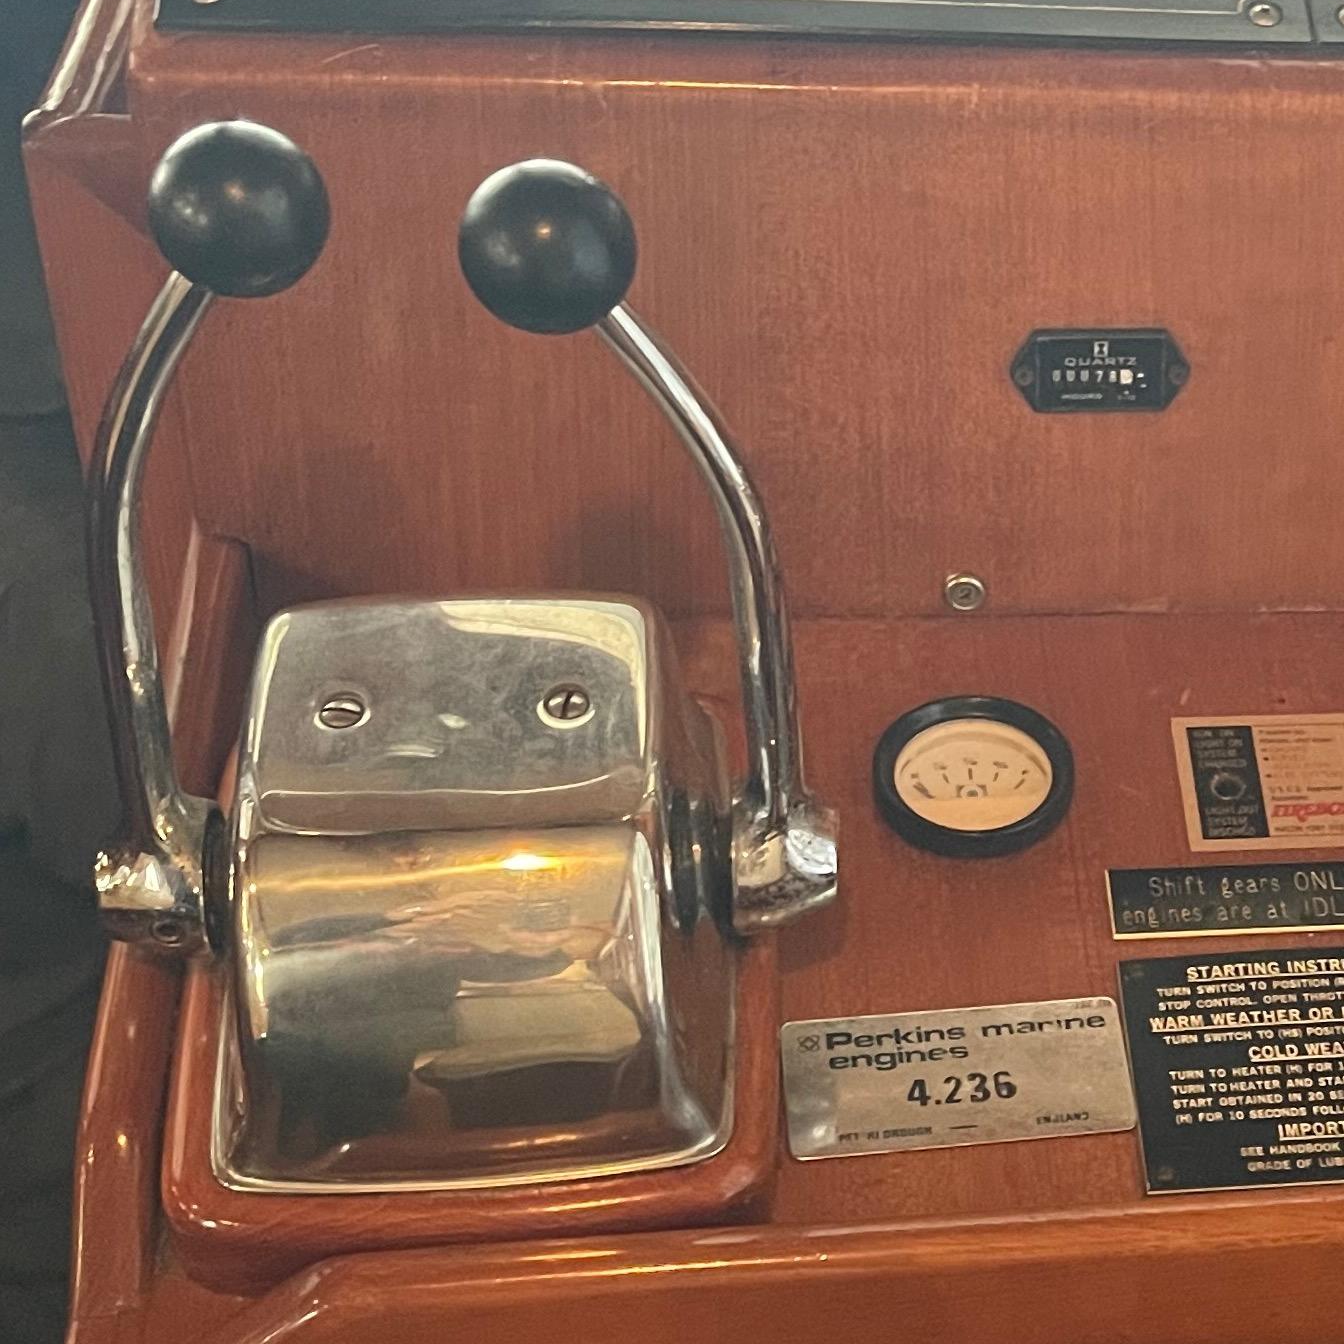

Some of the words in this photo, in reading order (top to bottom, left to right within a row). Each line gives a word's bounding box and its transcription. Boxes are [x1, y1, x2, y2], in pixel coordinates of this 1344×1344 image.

[1064, 357, 1137, 367] QUARTZ
[1150, 875, 1205, 897] Shift
[1221, 877, 1281, 899] gears
[1122, 906, 1203, 928] engines
[1216, 904, 1252, 922] are
[1266, 901, 1289, 919] at
[1186, 960, 1281, 980] STARTING
[1156, 986, 1191, 997] TURN
[1196, 982, 1246, 995] SWITCH
[1249, 981, 1267, 991] TO
[1272, 978, 1330, 989] POSITION
[1158, 1000, 1191, 1011] STOP
[1262, 994, 1297, 1004] OPEN
[1150, 1014, 1205, 1031] WARM
[1210, 1008, 1301, 1026] WEATHER
[1308, 1007, 1334, 1020] OR
[826, 1025, 966, 1050] Perkins
[981, 1015, 1105, 1037] marine
[1163, 1034, 1198, 1045] TURN
[1204, 1031, 1252, 1043] SWITCH
[1256, 1029, 1274, 1039] TO
[829, 1045, 969, 1071] engines
[1249, 1043, 1299, 1060] COLD
[1169, 1070, 1204, 1080] TURN
[1209, 1068, 1227, 1078] TO
[1232, 1065, 1282, 1076] HEATER
[1308, 1062, 1333, 1072] FOR
[907, 1071, 1017, 1107] 4.236
[1171, 1084, 1206, 1095] TURN
[1209, 1082, 1228, 1092] TO
[1230, 1079, 1281, 1091] HEATER
[1286, 1078, 1313, 1088] AND
[1172, 1097, 1213, 1109] START
[1218, 1093, 1283, 1106] OBTAINED
[1288, 1092, 1302, 1102] IN
[1308, 1091, 1325, 1101] 20
[1198, 1111, 1223, 1122] FOR
[1248, 1107, 1307, 1119] SECONDS
[1240, 1146, 1264, 1157] SEE
[1269, 1142, 1341, 1154] HANDBOOK
[1247, 1160, 1292, 1172] GRADE
[1296, 1158, 1313, 1169] OF
